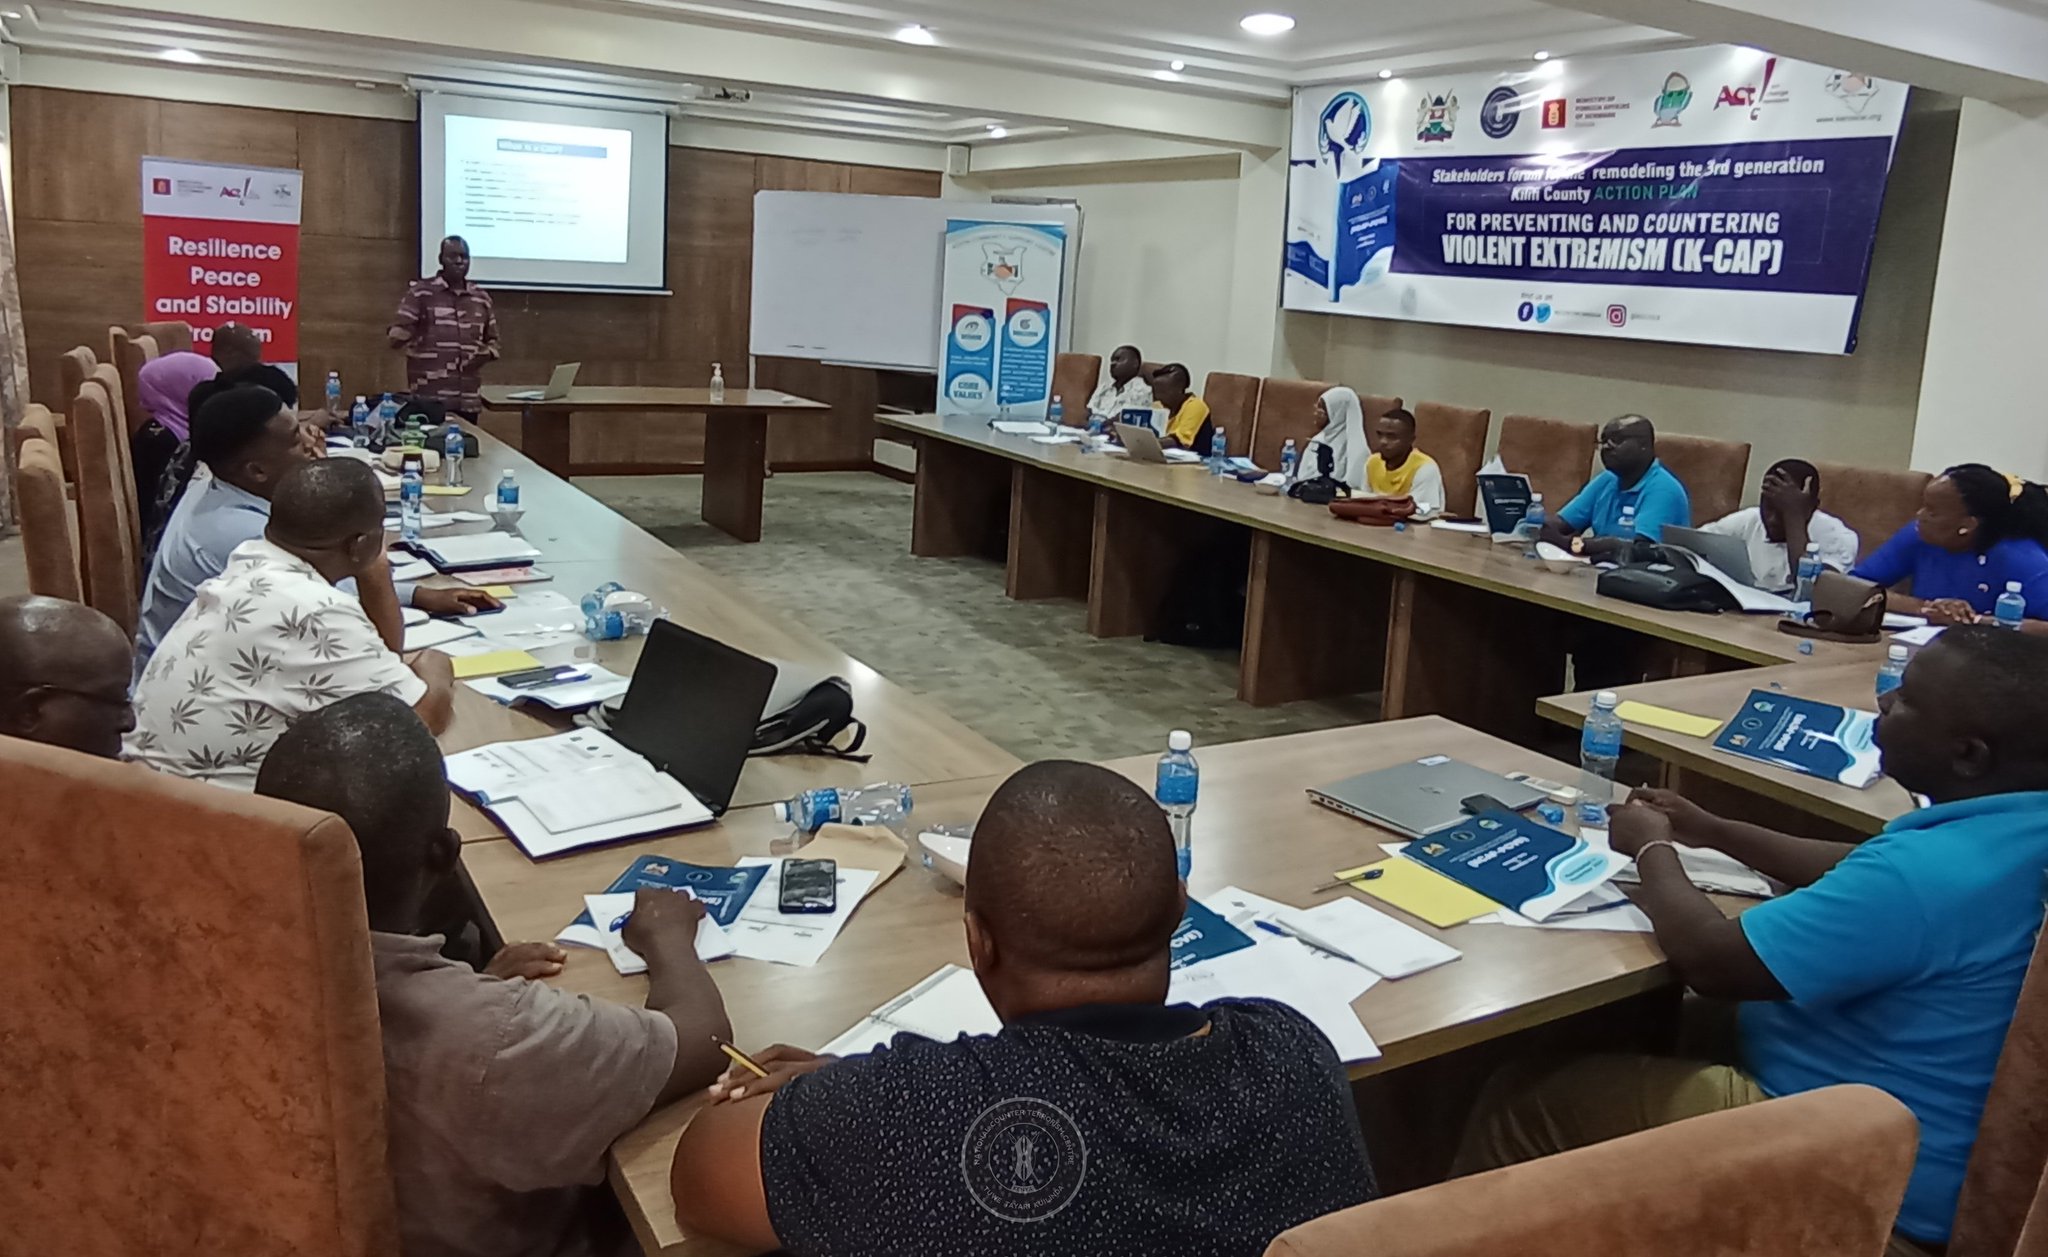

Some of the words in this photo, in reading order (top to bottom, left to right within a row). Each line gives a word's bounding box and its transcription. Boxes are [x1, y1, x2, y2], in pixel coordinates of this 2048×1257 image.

[1432, 167, 1505, 183] Stakeholders
[1507, 166, 1545, 182] forum
[1593, 162, 1675, 181] remodeling
[1679, 160, 1702, 177] the
[1704, 158, 1731, 176] 3rd
[1734, 156, 1825, 178] generation
[1543, 186, 1591, 204] County
[1594, 184, 1654, 201] ACTION
[1658, 183, 1699, 199] PLAN
[1446, 212, 1476, 231] FOR
[1480, 213, 1594, 233] PREVENTING
[1598, 213, 1640, 233] AND
[1643, 212, 1780, 234] COUNTERING
[168, 236, 282, 260] Resilience
[1441, 234, 1526, 267] VIOLENT
[1530, 236, 1668, 271] EXTREMISM
[190, 266, 261, 287] Peace
[156, 296, 200, 313] and
[206, 295, 293, 319] Stability
